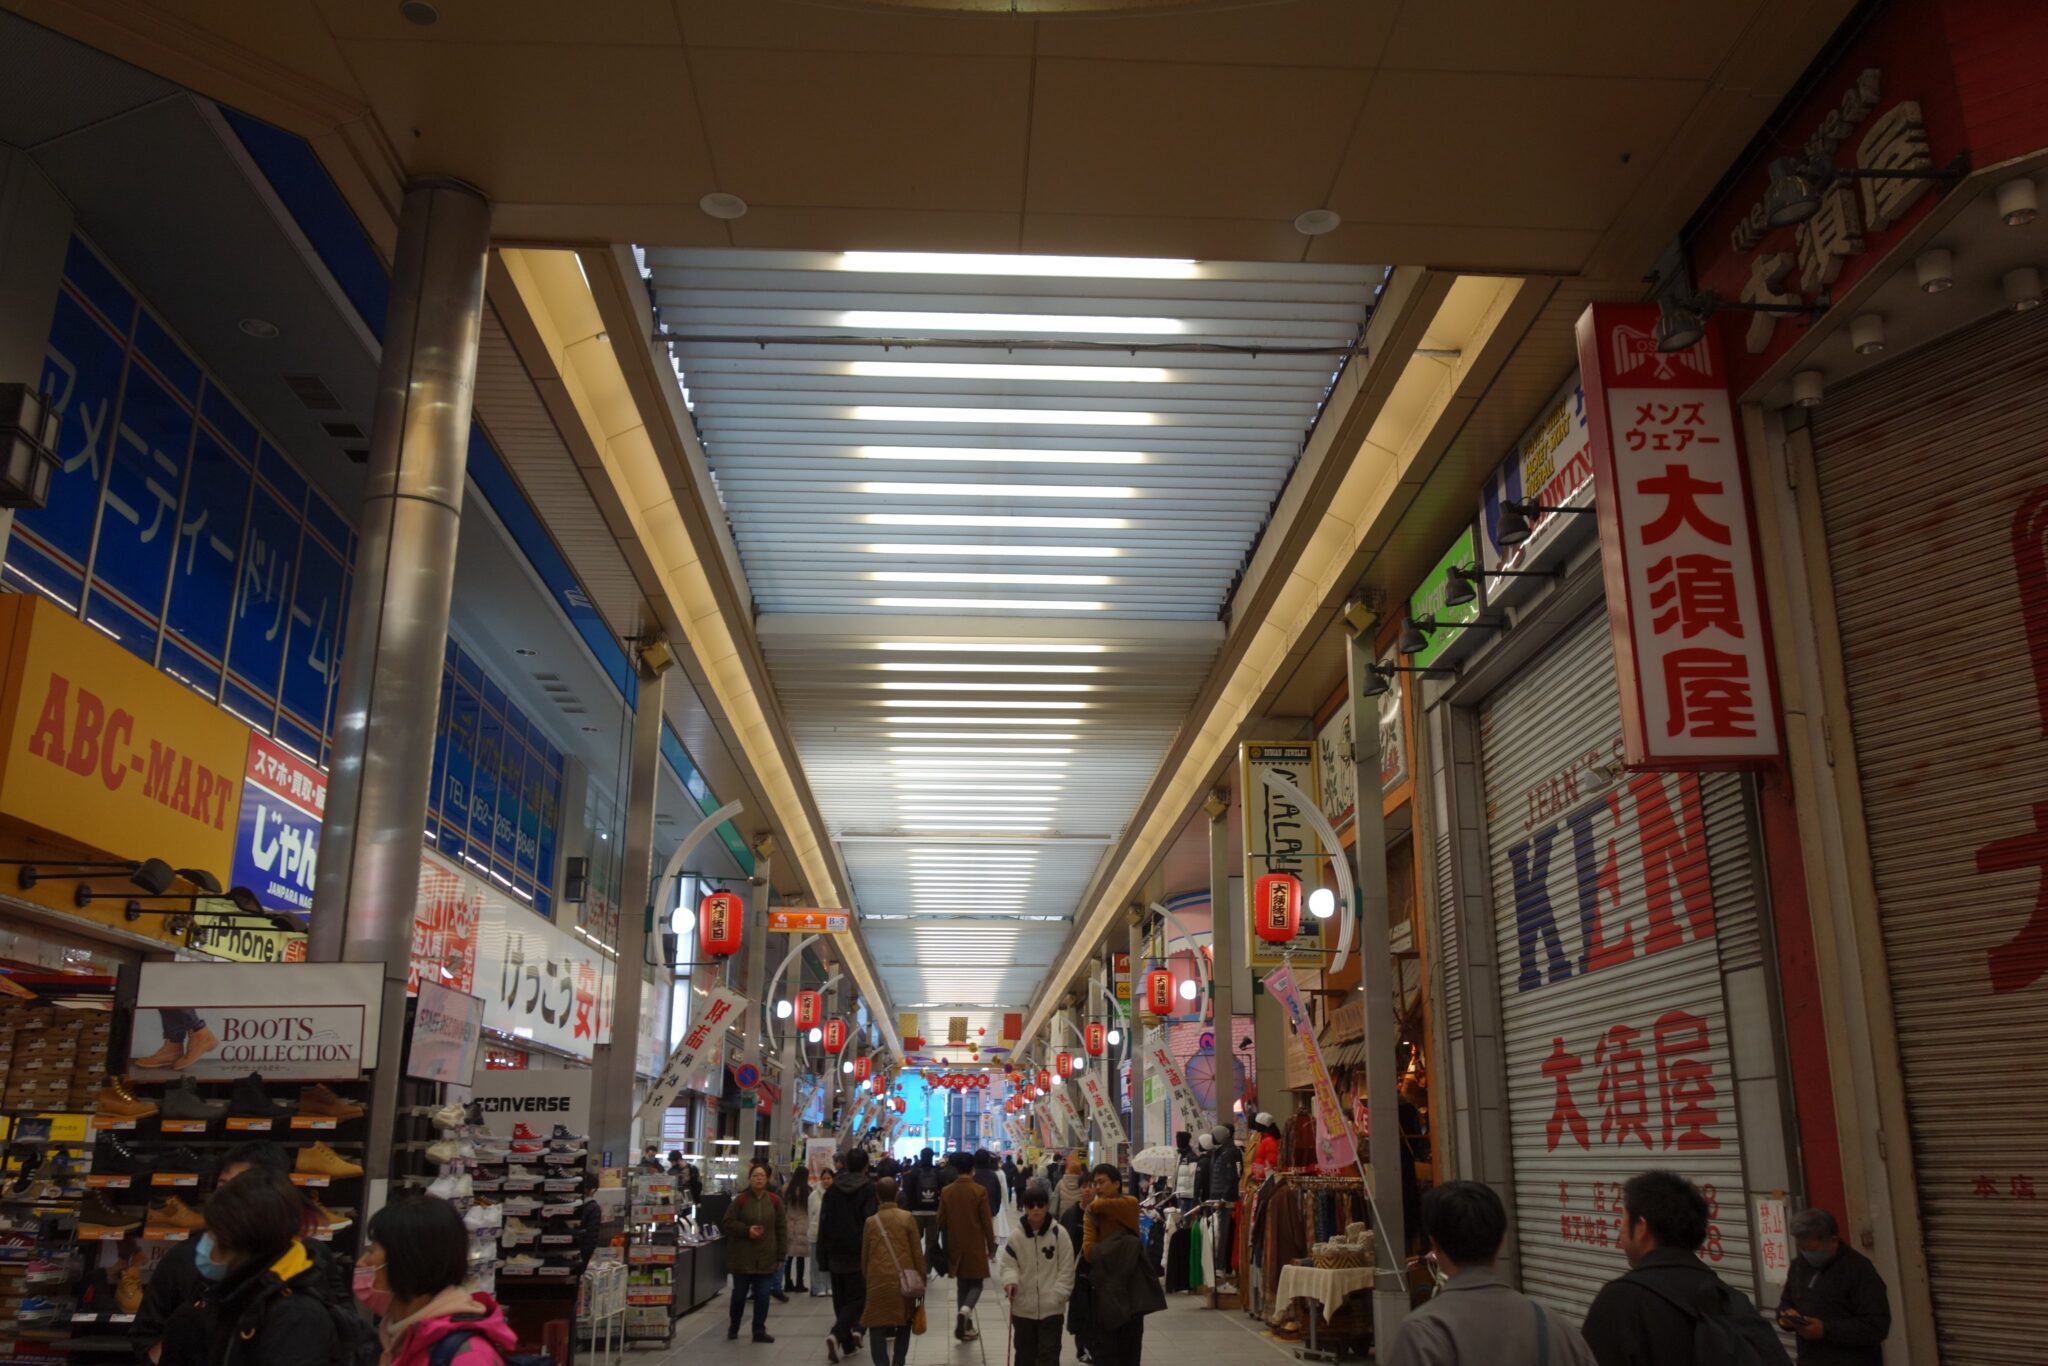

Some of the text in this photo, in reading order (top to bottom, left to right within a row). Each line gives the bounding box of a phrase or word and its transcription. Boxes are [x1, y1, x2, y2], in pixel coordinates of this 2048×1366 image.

[1634, 402, 1706, 427] メンズ
[1625, 428, 1720, 452] ウェアー
[1529, 440, 1595, 529] DWIN
[1636, 464, 1757, 738] 大須屋
[29, 671, 233, 831] ABC-MART
[266, 881, 299, 905] JANPARA
[220, 1017, 314, 1041] BOOTS
[220, 1044, 353, 1062] COLLECTION
[1541, 1010, 1721, 1153] 大須屋
[474, 1097, 570, 1112] CONVERSE
